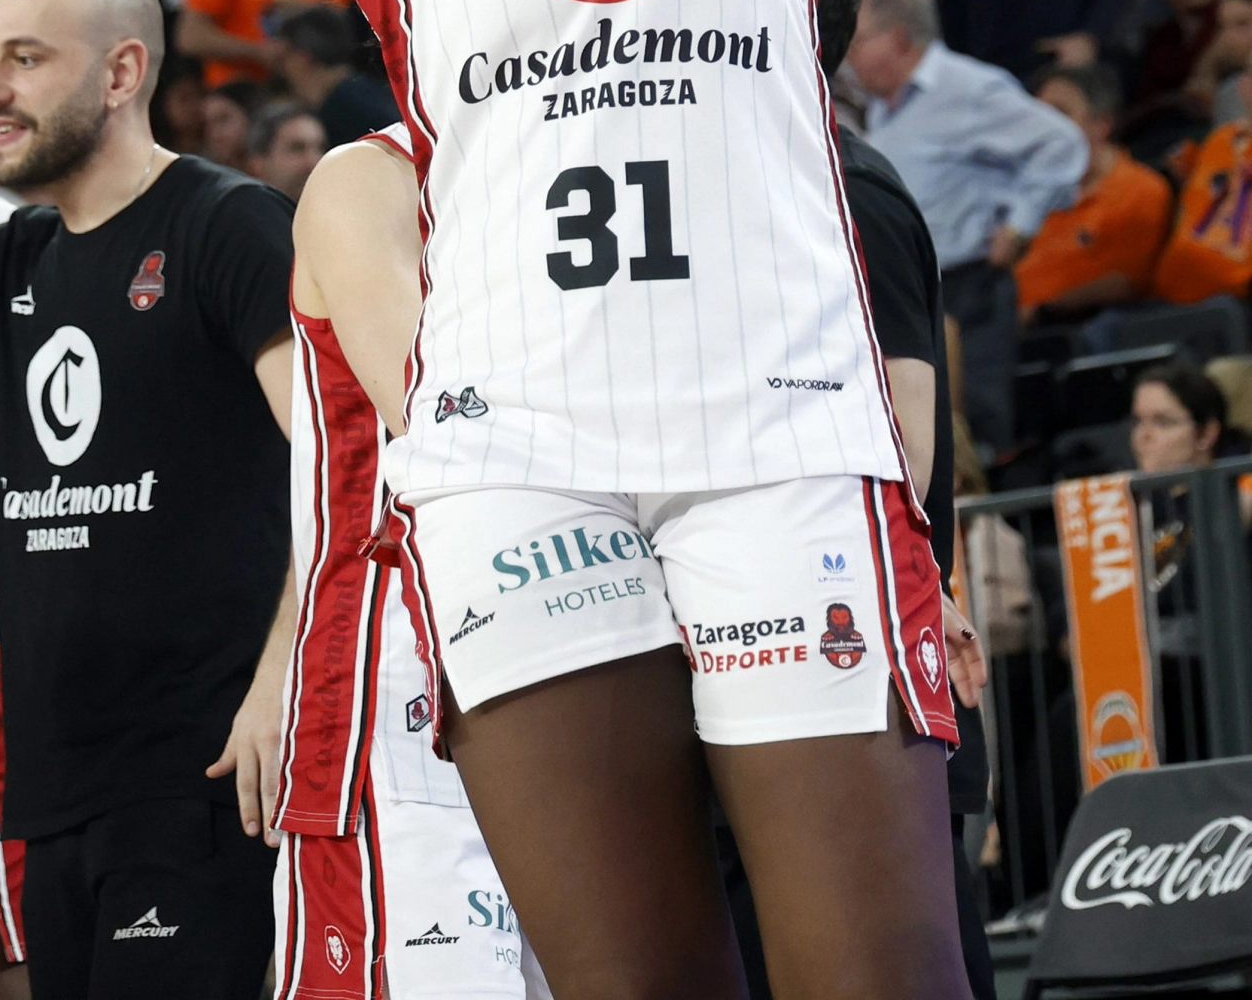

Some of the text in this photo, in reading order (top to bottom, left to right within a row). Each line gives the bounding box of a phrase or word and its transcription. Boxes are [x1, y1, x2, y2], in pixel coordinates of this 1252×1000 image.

[457, 17, 772, 105] Casademont
[542, 77, 698, 122] ZARAGOZA
[545, 159, 691, 292] 31
[0, 469, 159, 520] asademont
[25, 525, 90, 552] ZARAGOZA
[544, 577, 647, 617] HOTELES
[449, 611, 496, 646] MERCURY
[692, 616, 806, 647] Zaragoza
[112, 925, 181, 941] MERCURY
[405, 936, 461, 948] MERCURY
